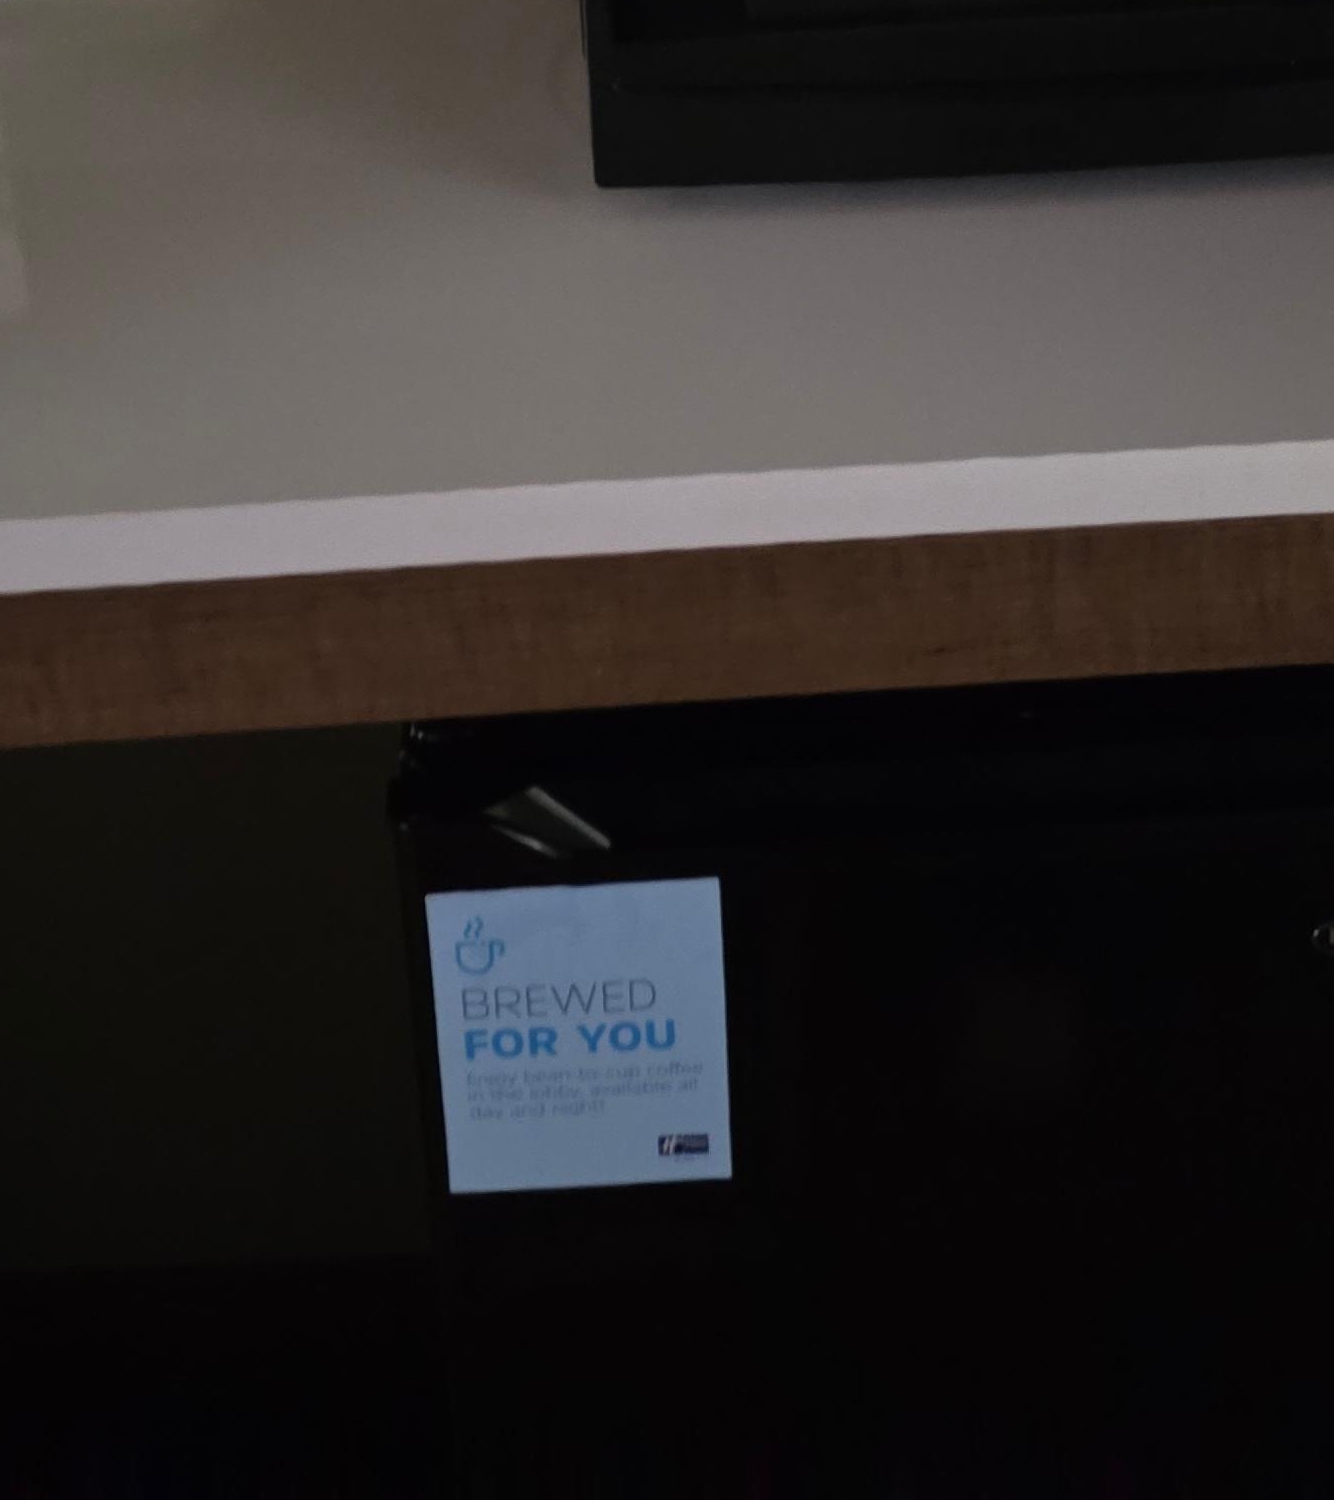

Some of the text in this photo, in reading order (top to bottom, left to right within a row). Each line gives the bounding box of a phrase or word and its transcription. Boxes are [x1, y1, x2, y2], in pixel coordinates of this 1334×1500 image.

[461, 977, 657, 1021] BREWED
[463, 1018, 677, 1061] FOR YOU
[646, 1060, 703, 1077] coffee
